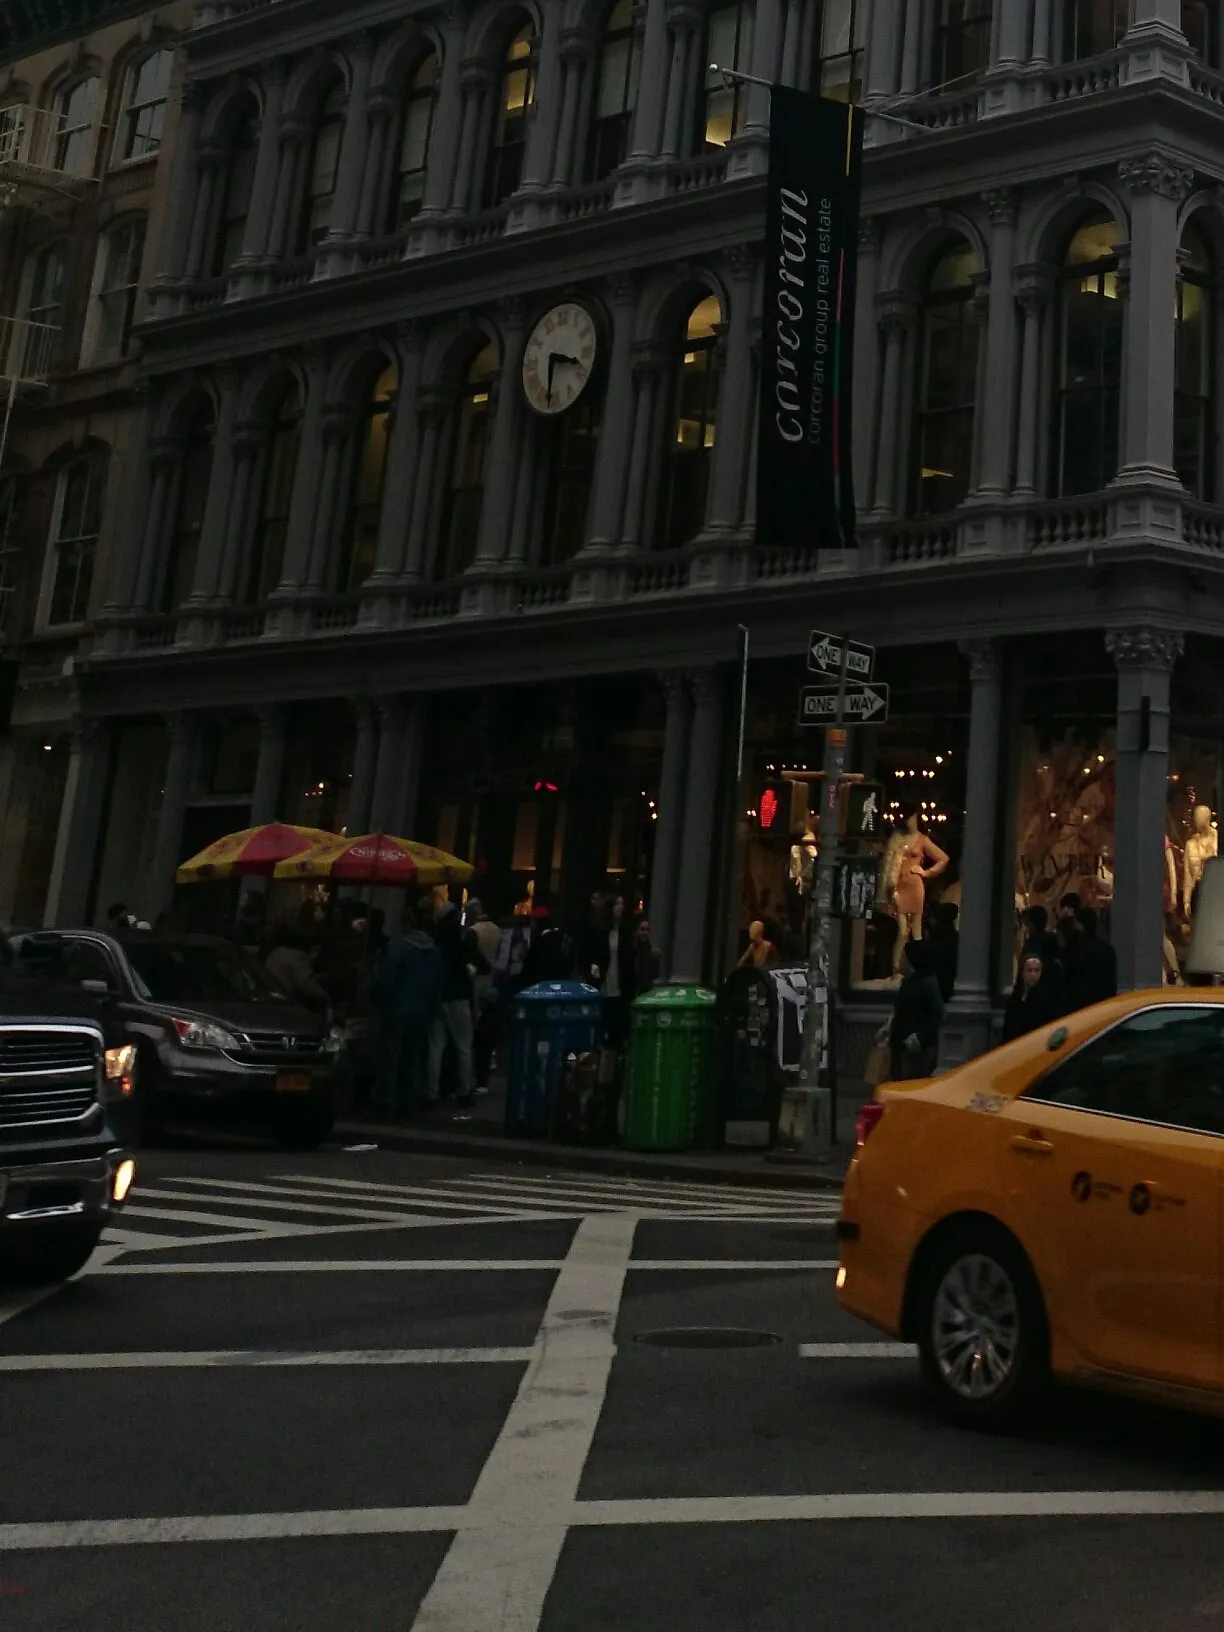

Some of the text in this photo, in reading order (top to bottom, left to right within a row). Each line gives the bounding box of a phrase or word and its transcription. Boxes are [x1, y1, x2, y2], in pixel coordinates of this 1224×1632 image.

[776, 187, 809, 442] corcoran
[807, 197, 832, 445] corcoran group real estate
[807, 696, 877, 712] ONE WAY
[816, 645, 869, 671] ONE WAY
